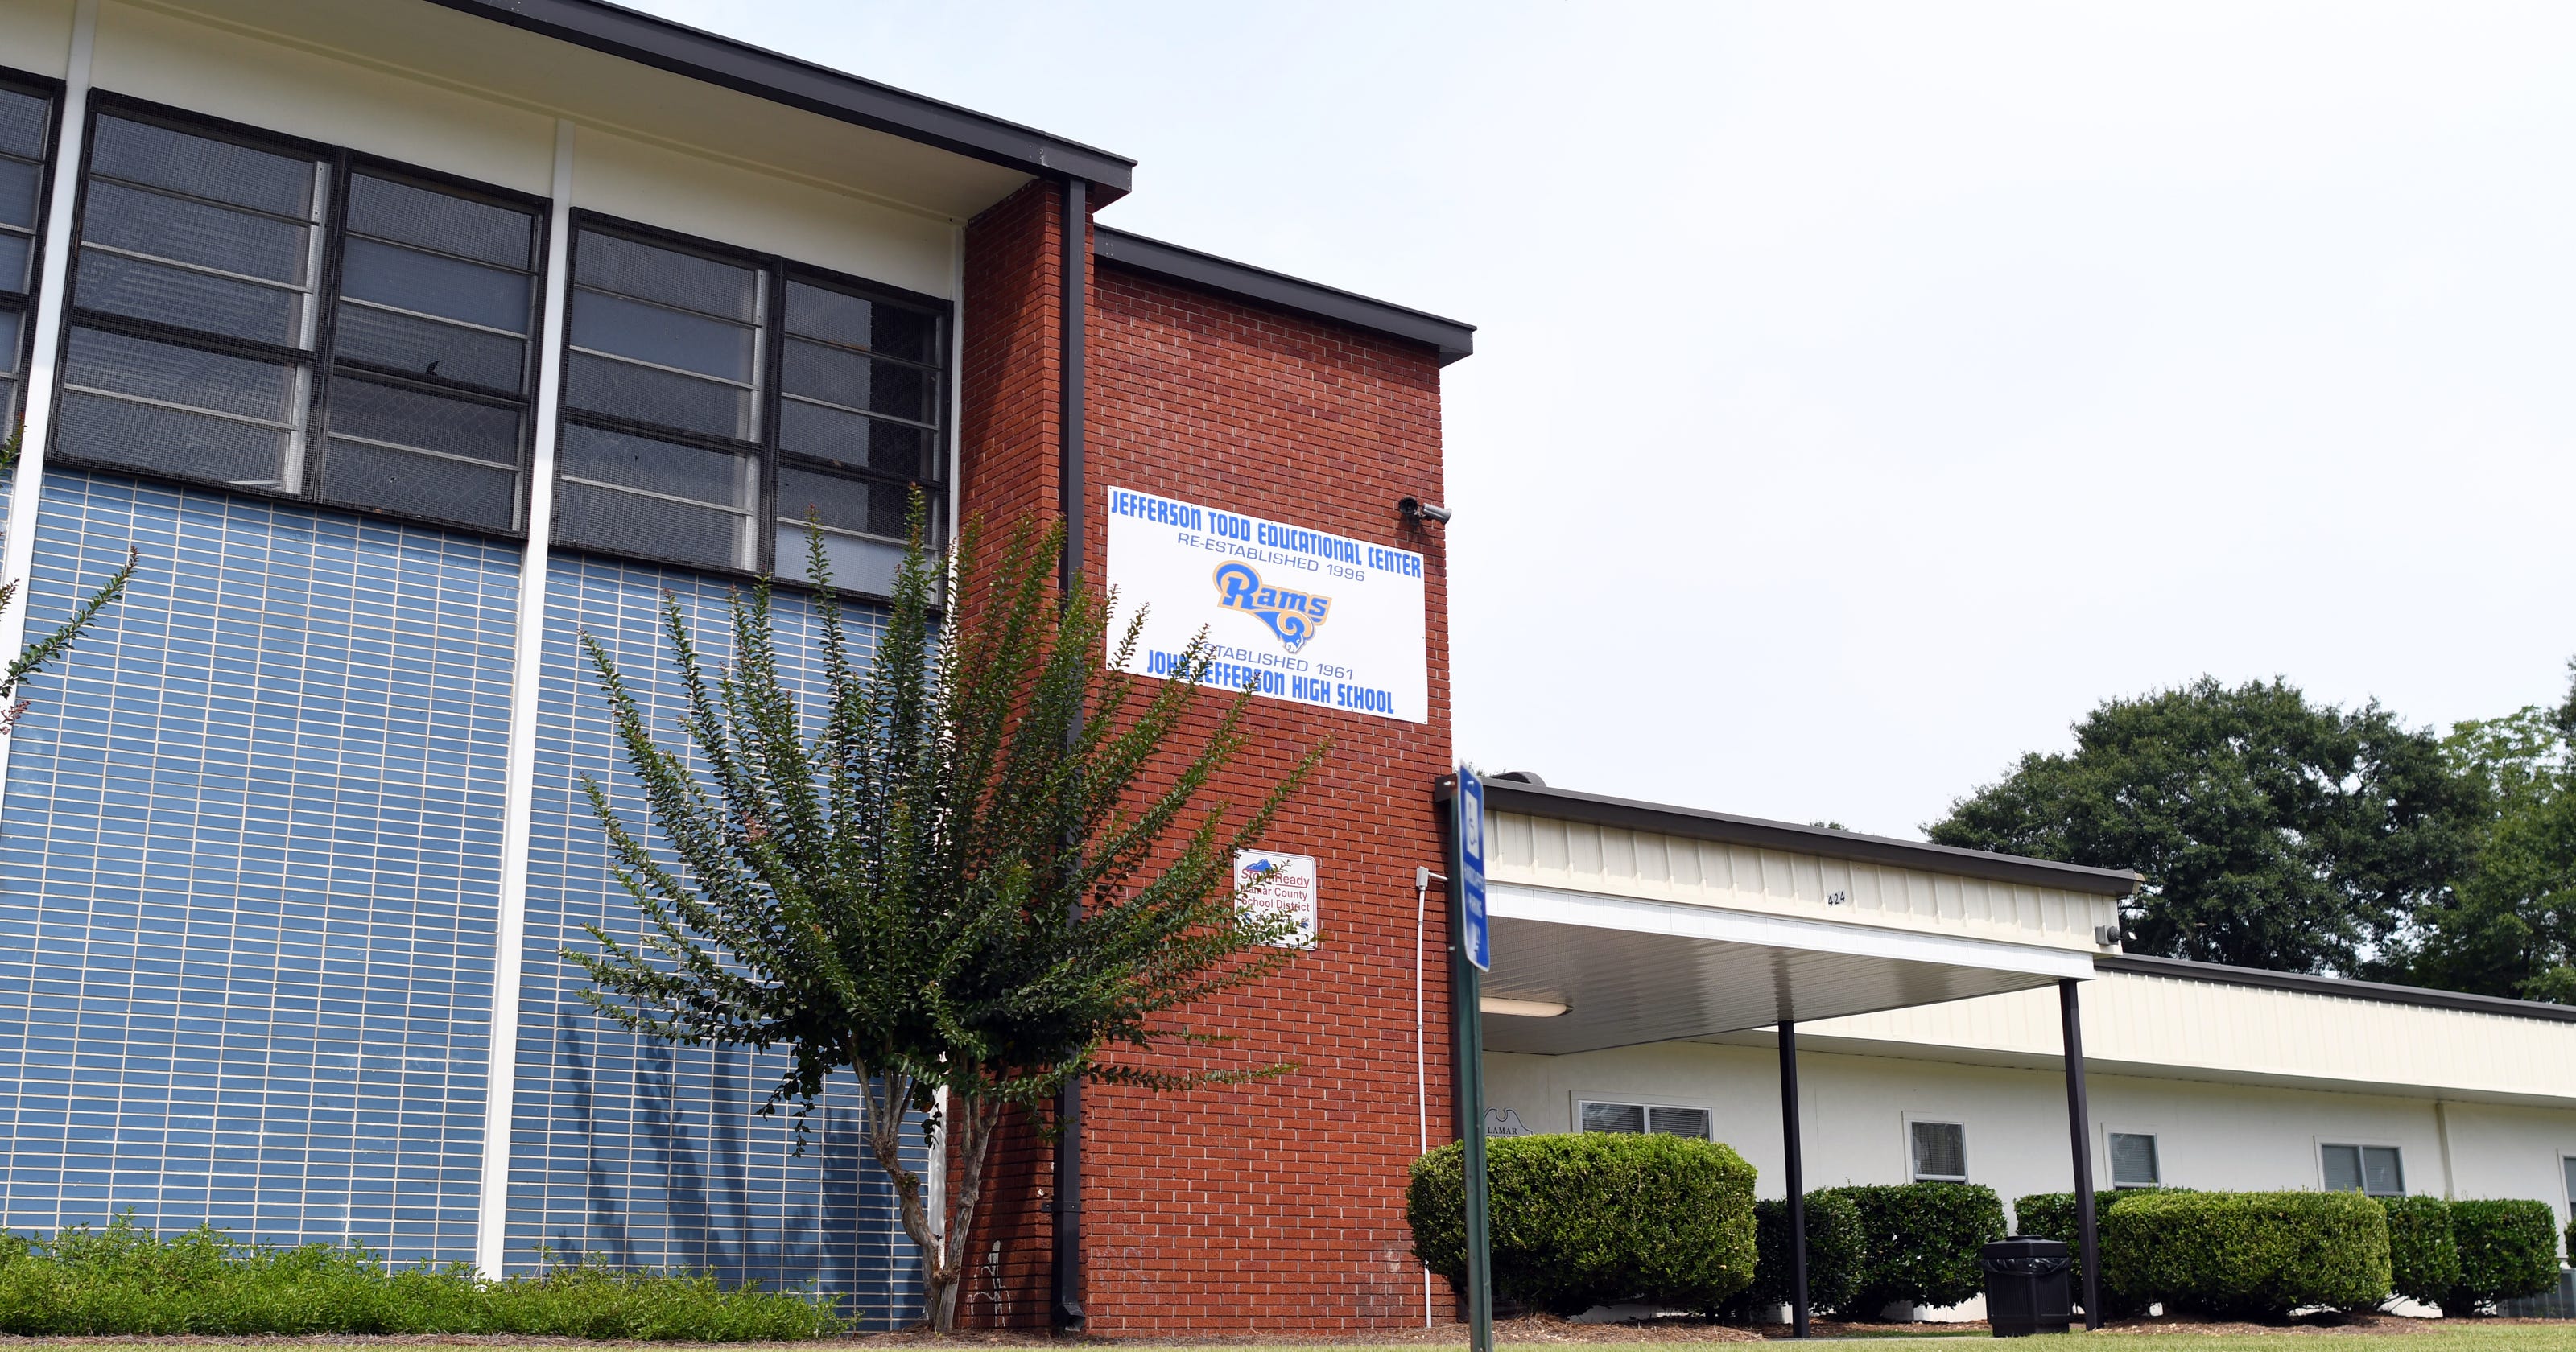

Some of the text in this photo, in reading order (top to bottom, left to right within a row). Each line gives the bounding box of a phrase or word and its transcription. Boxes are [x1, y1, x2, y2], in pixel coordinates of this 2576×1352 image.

[1111, 490, 1422, 579] JEFFERSON TODD EDUCATIONAL CENTER
[1177, 533, 1365, 582] RE-ESTABLISHED 1996
[1214, 562, 1331, 620] Rams
[1195, 642, 1354, 681] STABLISHED 1961
[1194, 658, 1285, 696] EFFERSON
[1292, 675, 1331, 703] HIGH
[1337, 683, 1394, 715] SCHOOL
[1241, 868, 1310, 888] StoReady
[1241, 896, 1310, 912] School District
[1274, 887, 1307, 901] County
[1828, 891, 1845, 906] 424
[1487, 1127, 1517, 1135] LAMAR
